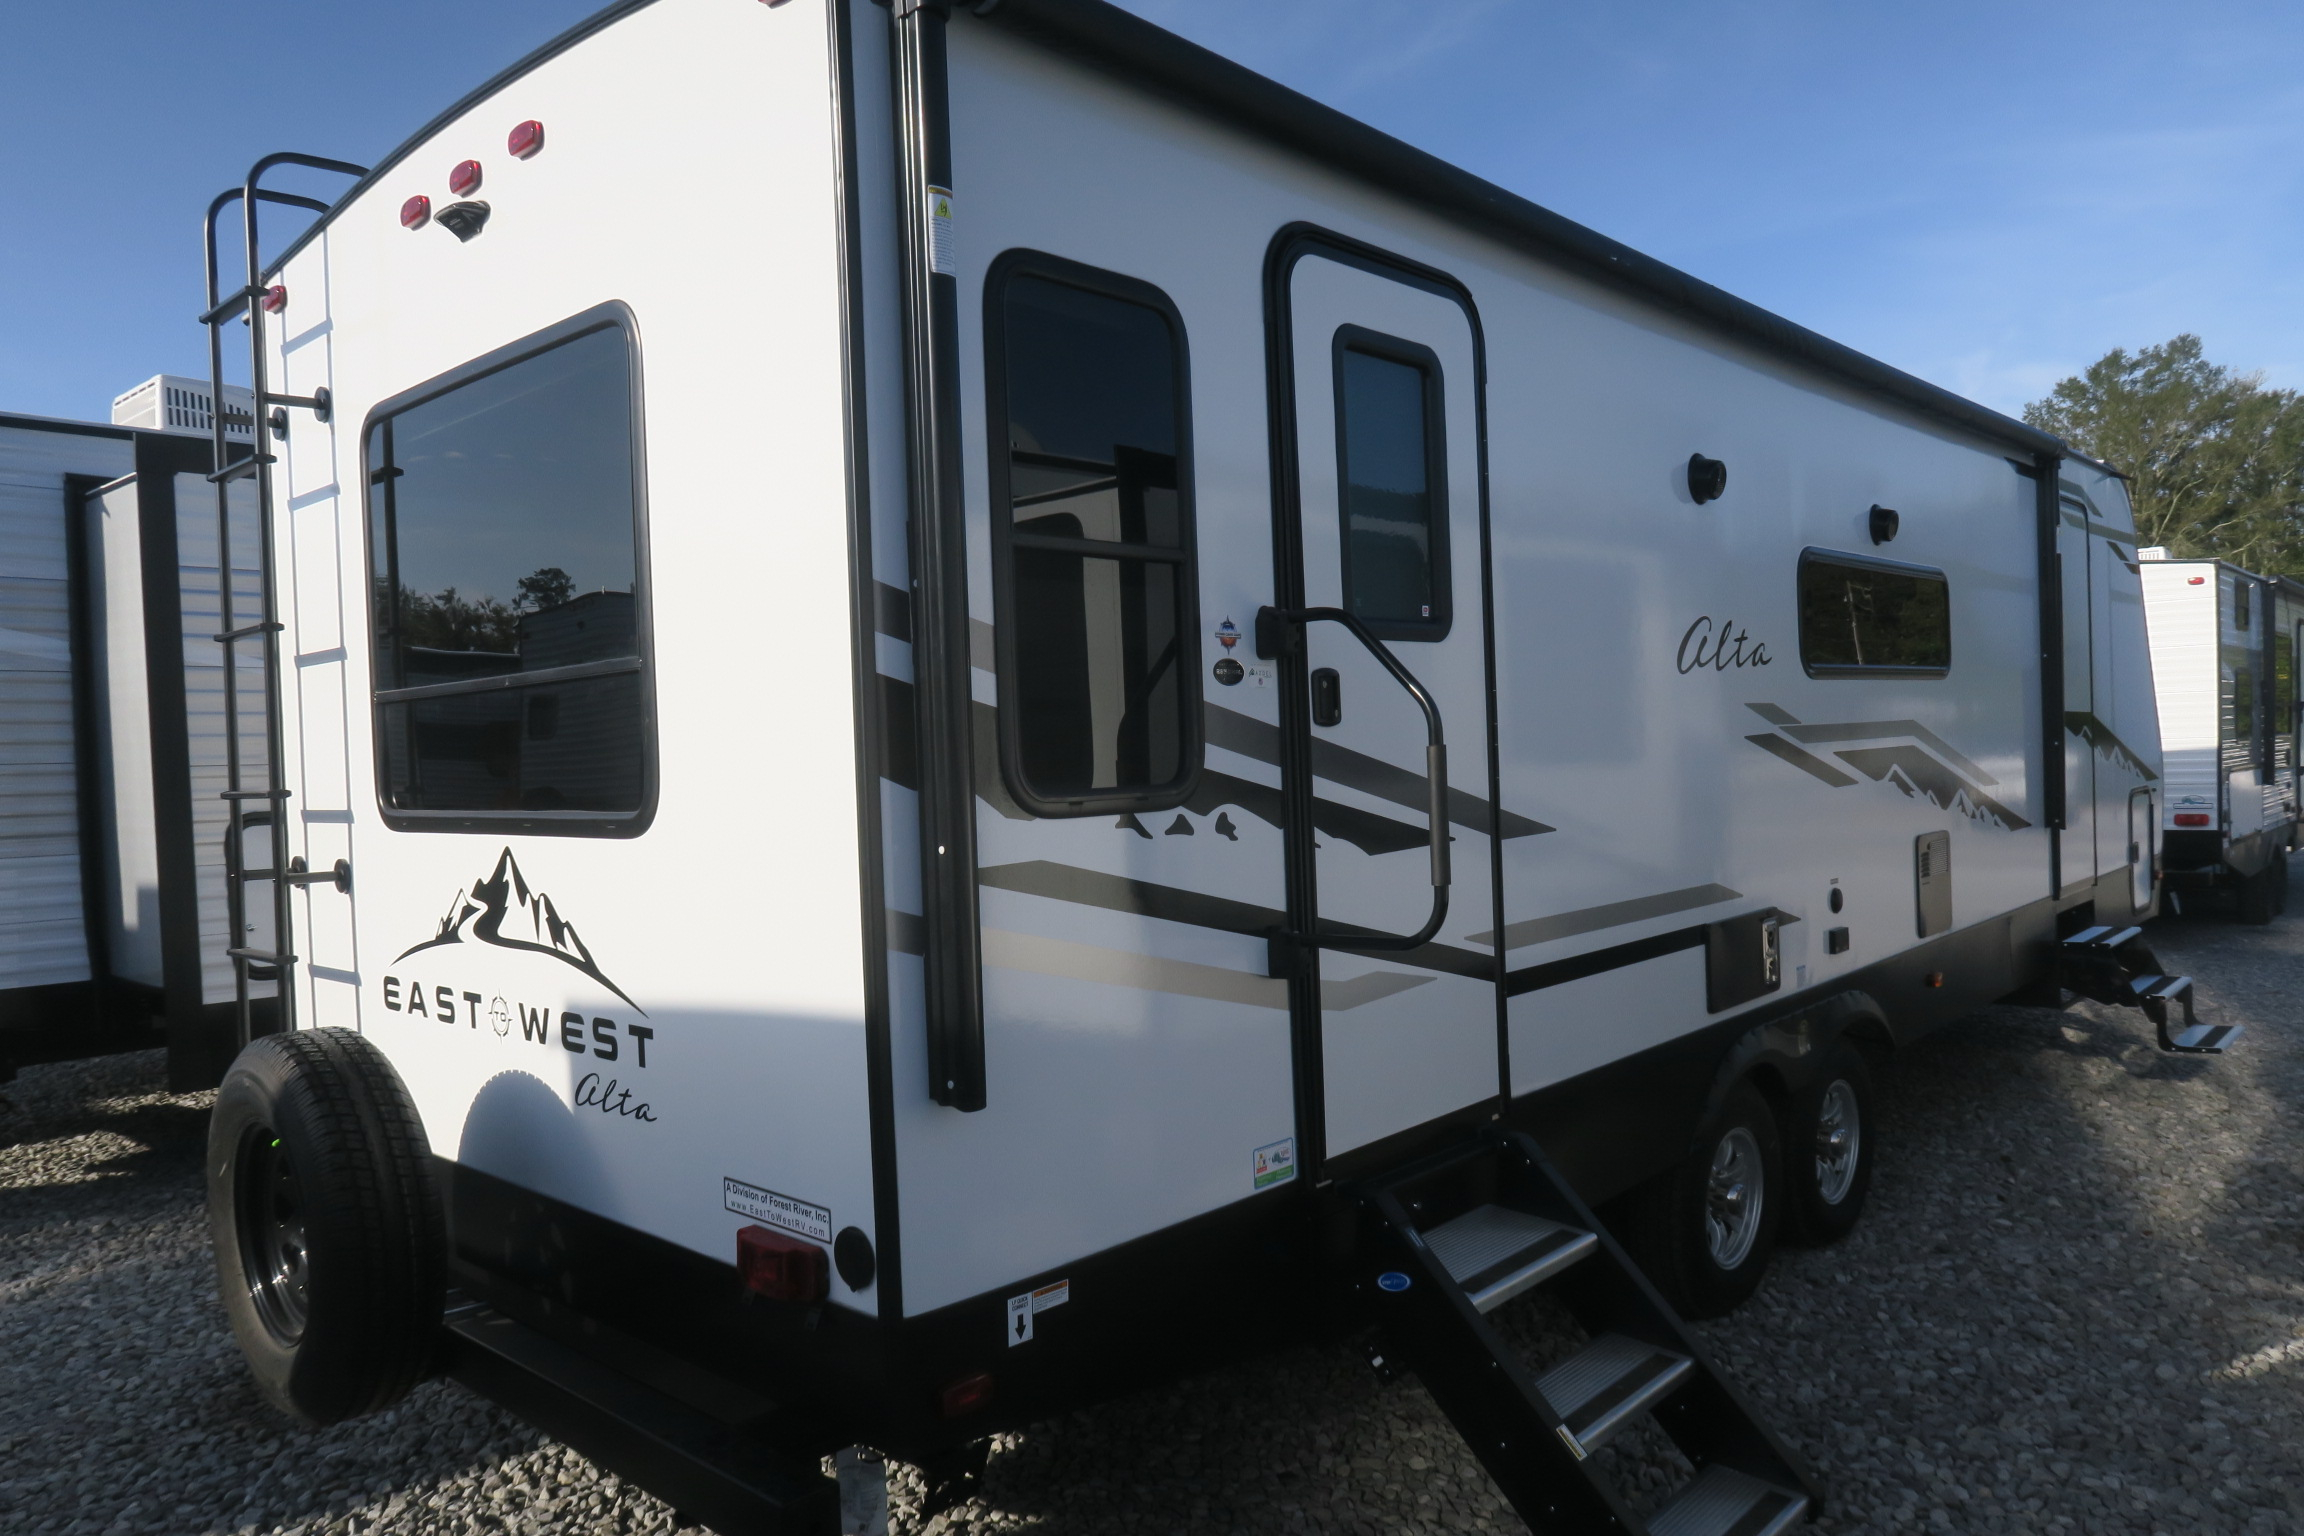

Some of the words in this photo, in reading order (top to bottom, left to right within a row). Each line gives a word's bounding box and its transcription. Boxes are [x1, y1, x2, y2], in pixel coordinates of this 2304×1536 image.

[1677, 615, 1773, 675] Alta
[383, 975, 482, 1030] EAST
[493, 1010, 507, 1022] TO
[518, 1002, 654, 1069] WEST
[574, 1072, 658, 1122] Alta
[726, 1182, 732, 1192] A
[732, 1184, 760, 1202] Division
[760, 1194, 768, 1204] of
[769, 1196, 792, 1212] Forest
[793, 1203, 814, 1221] River,
[815, 1210, 829, 1224] Inc.
[730, 1199, 826, 1238] www.EastToWestRV.com
[1011, 1301, 1029, 1311] CONNECT
